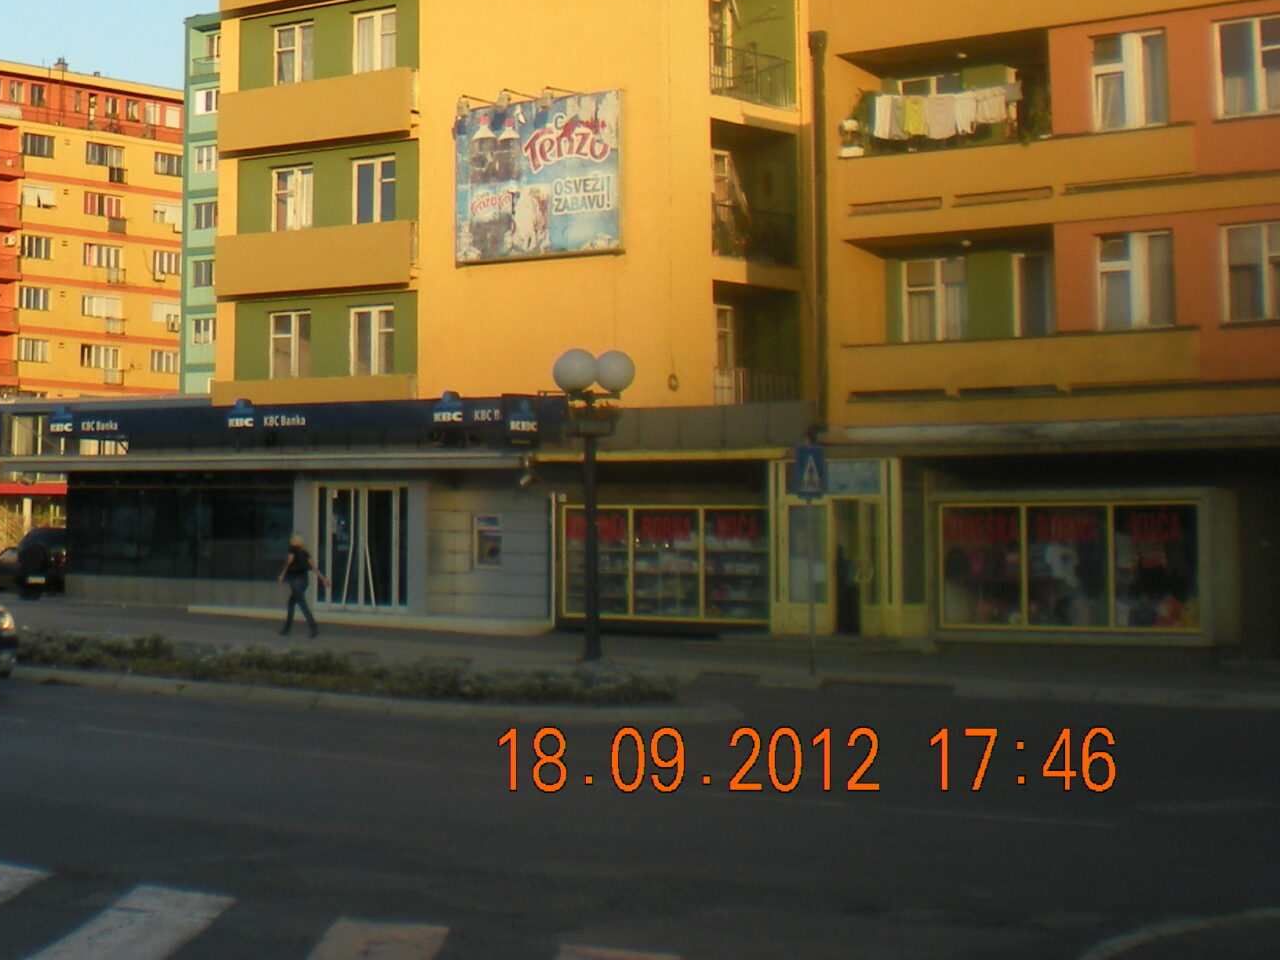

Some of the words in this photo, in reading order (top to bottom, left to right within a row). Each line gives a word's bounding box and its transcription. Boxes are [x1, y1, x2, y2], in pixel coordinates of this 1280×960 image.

[263, 415, 279, 427] KBC
[281, 414, 306, 427] Banka
[433, 411, 463, 423] KBC
[473, 409, 492, 421] KBC
[49, 422, 73, 433] KBC
[80, 419, 95, 432] KBC
[96, 419, 118, 431] Banka
[228, 417, 254, 428] KBC
[509, 420, 538, 432] KBC
